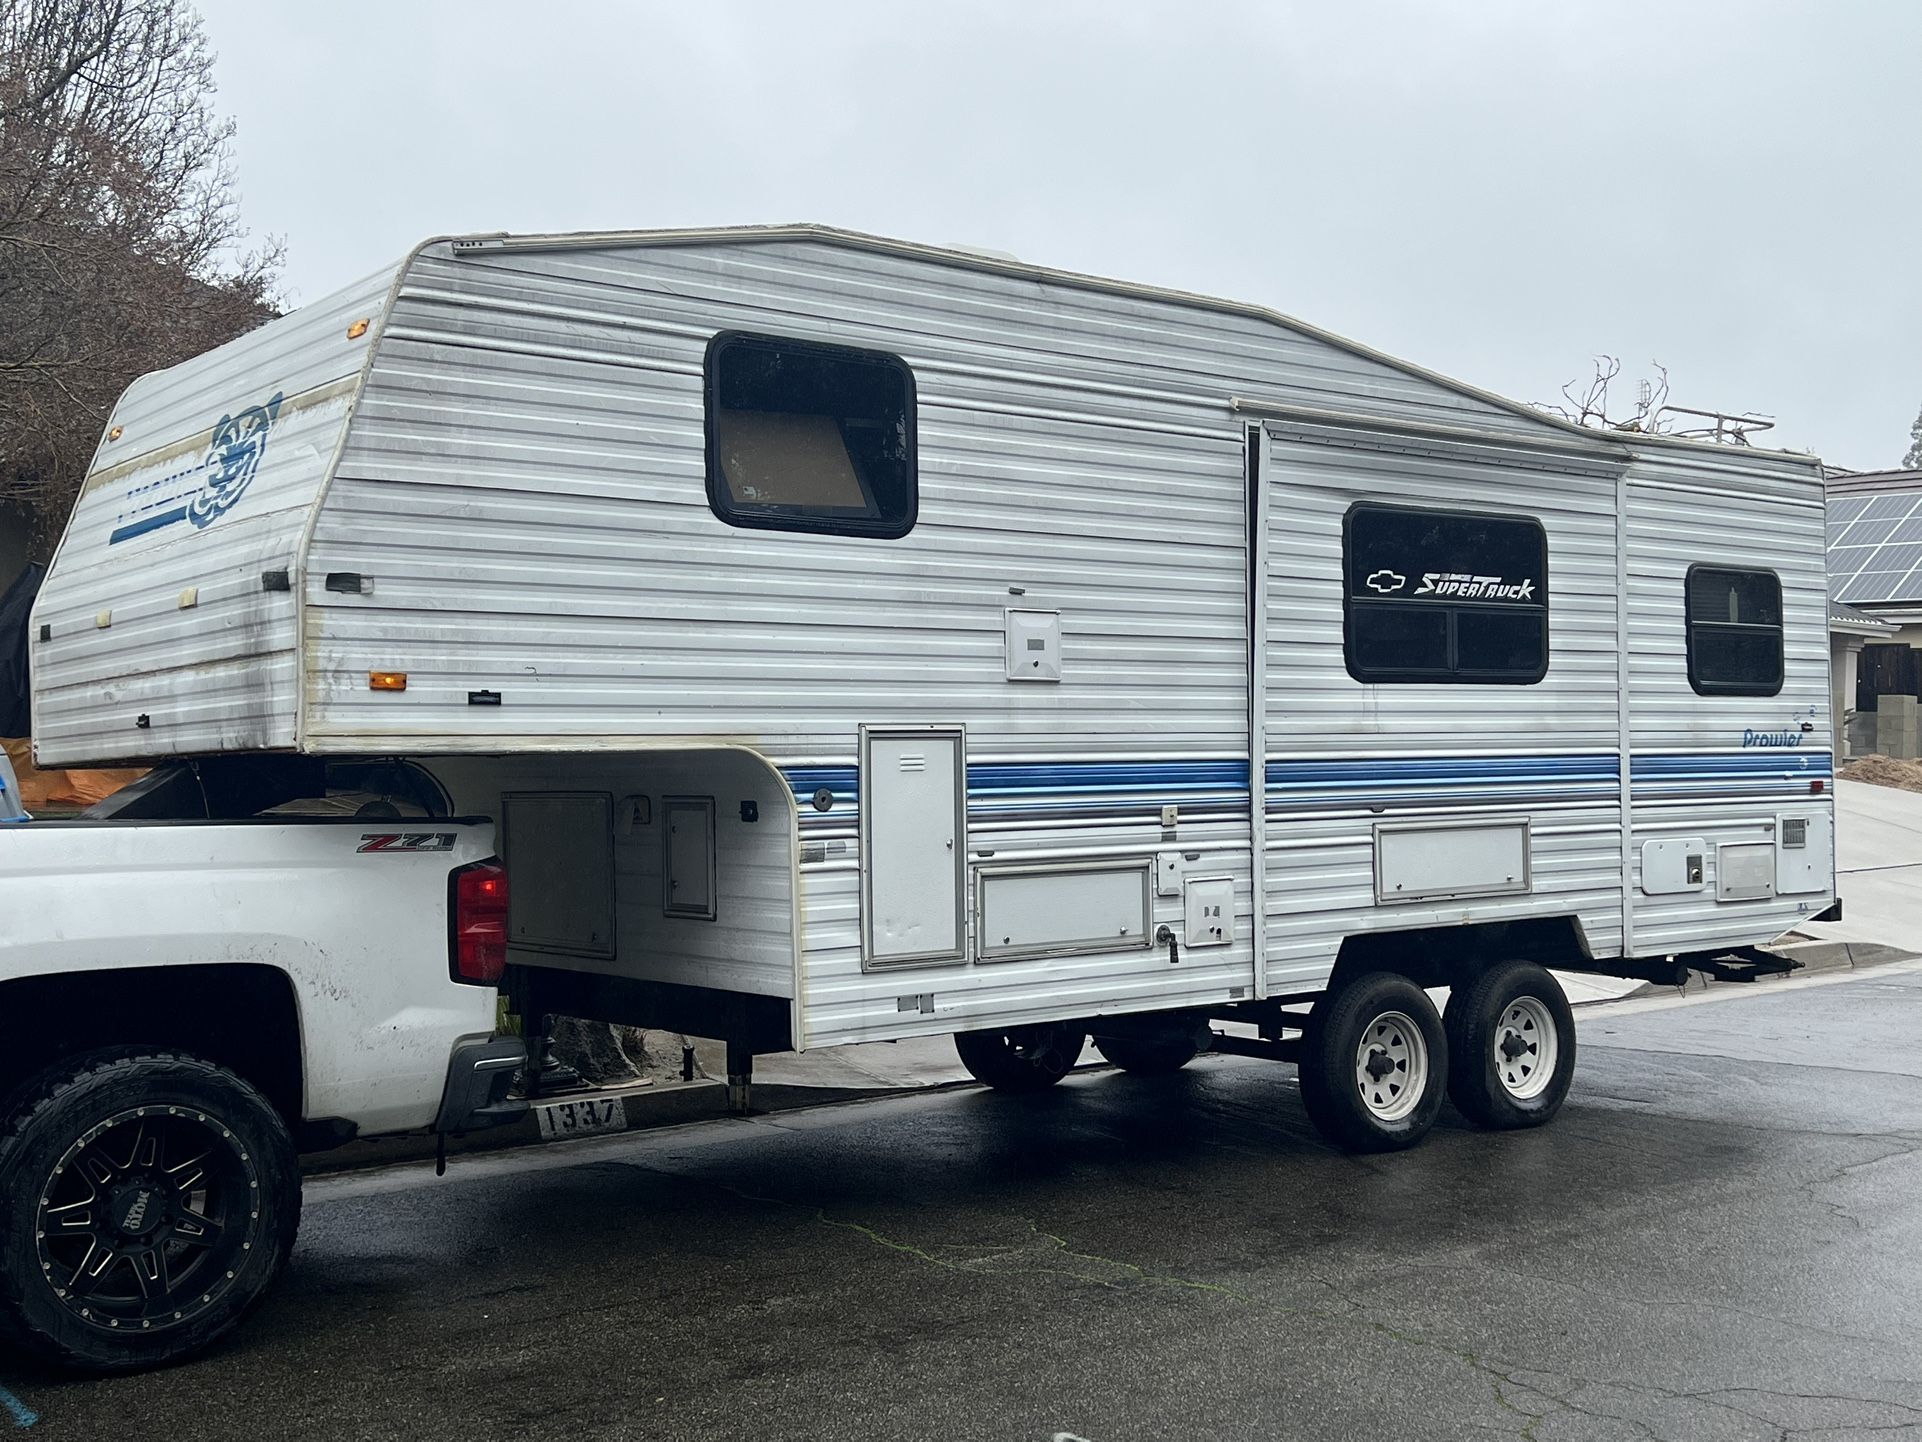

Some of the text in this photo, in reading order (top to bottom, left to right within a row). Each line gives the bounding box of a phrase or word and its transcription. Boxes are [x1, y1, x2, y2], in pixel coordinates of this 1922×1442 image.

[1743, 729, 1803, 748] Prowler
[356, 833, 457, 853] Z71
[546, 1099, 614, 1132] 1337
